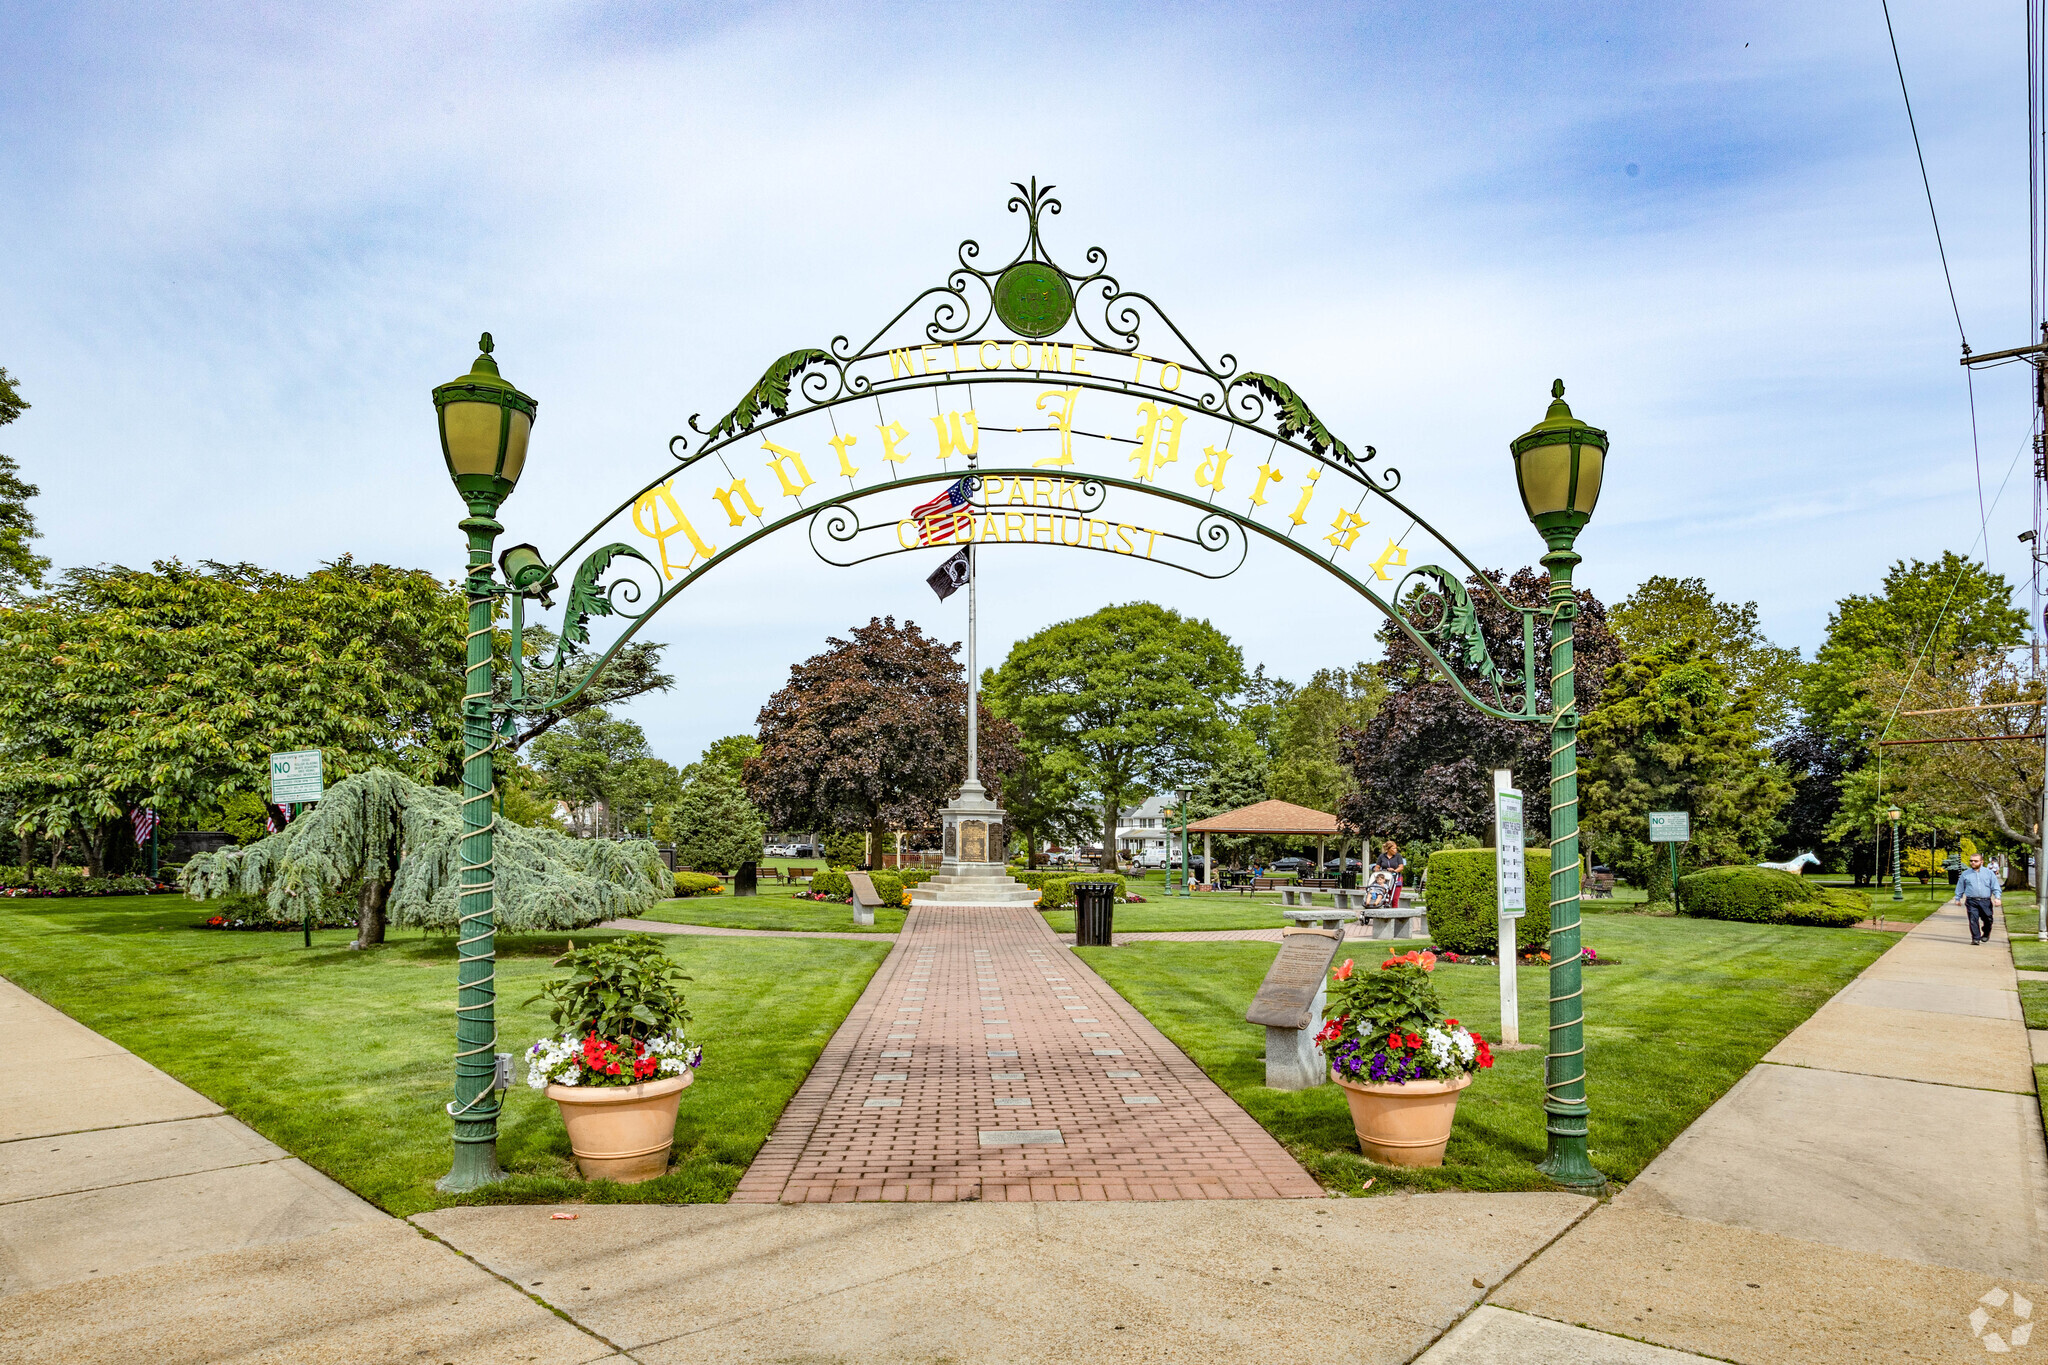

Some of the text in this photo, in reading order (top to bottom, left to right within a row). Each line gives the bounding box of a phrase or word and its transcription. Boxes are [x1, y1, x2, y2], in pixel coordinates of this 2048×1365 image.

[888, 340, 1182, 391] WELCOME TO
[632, 408, 979, 581] Andrew
[1128, 402, 1409, 581] Parise
[983, 475, 1082, 510] PARK
[897, 511, 1164, 559] CEDARHURST
[274, 762, 290, 774] NO
[1652, 817, 1665, 825] NO
